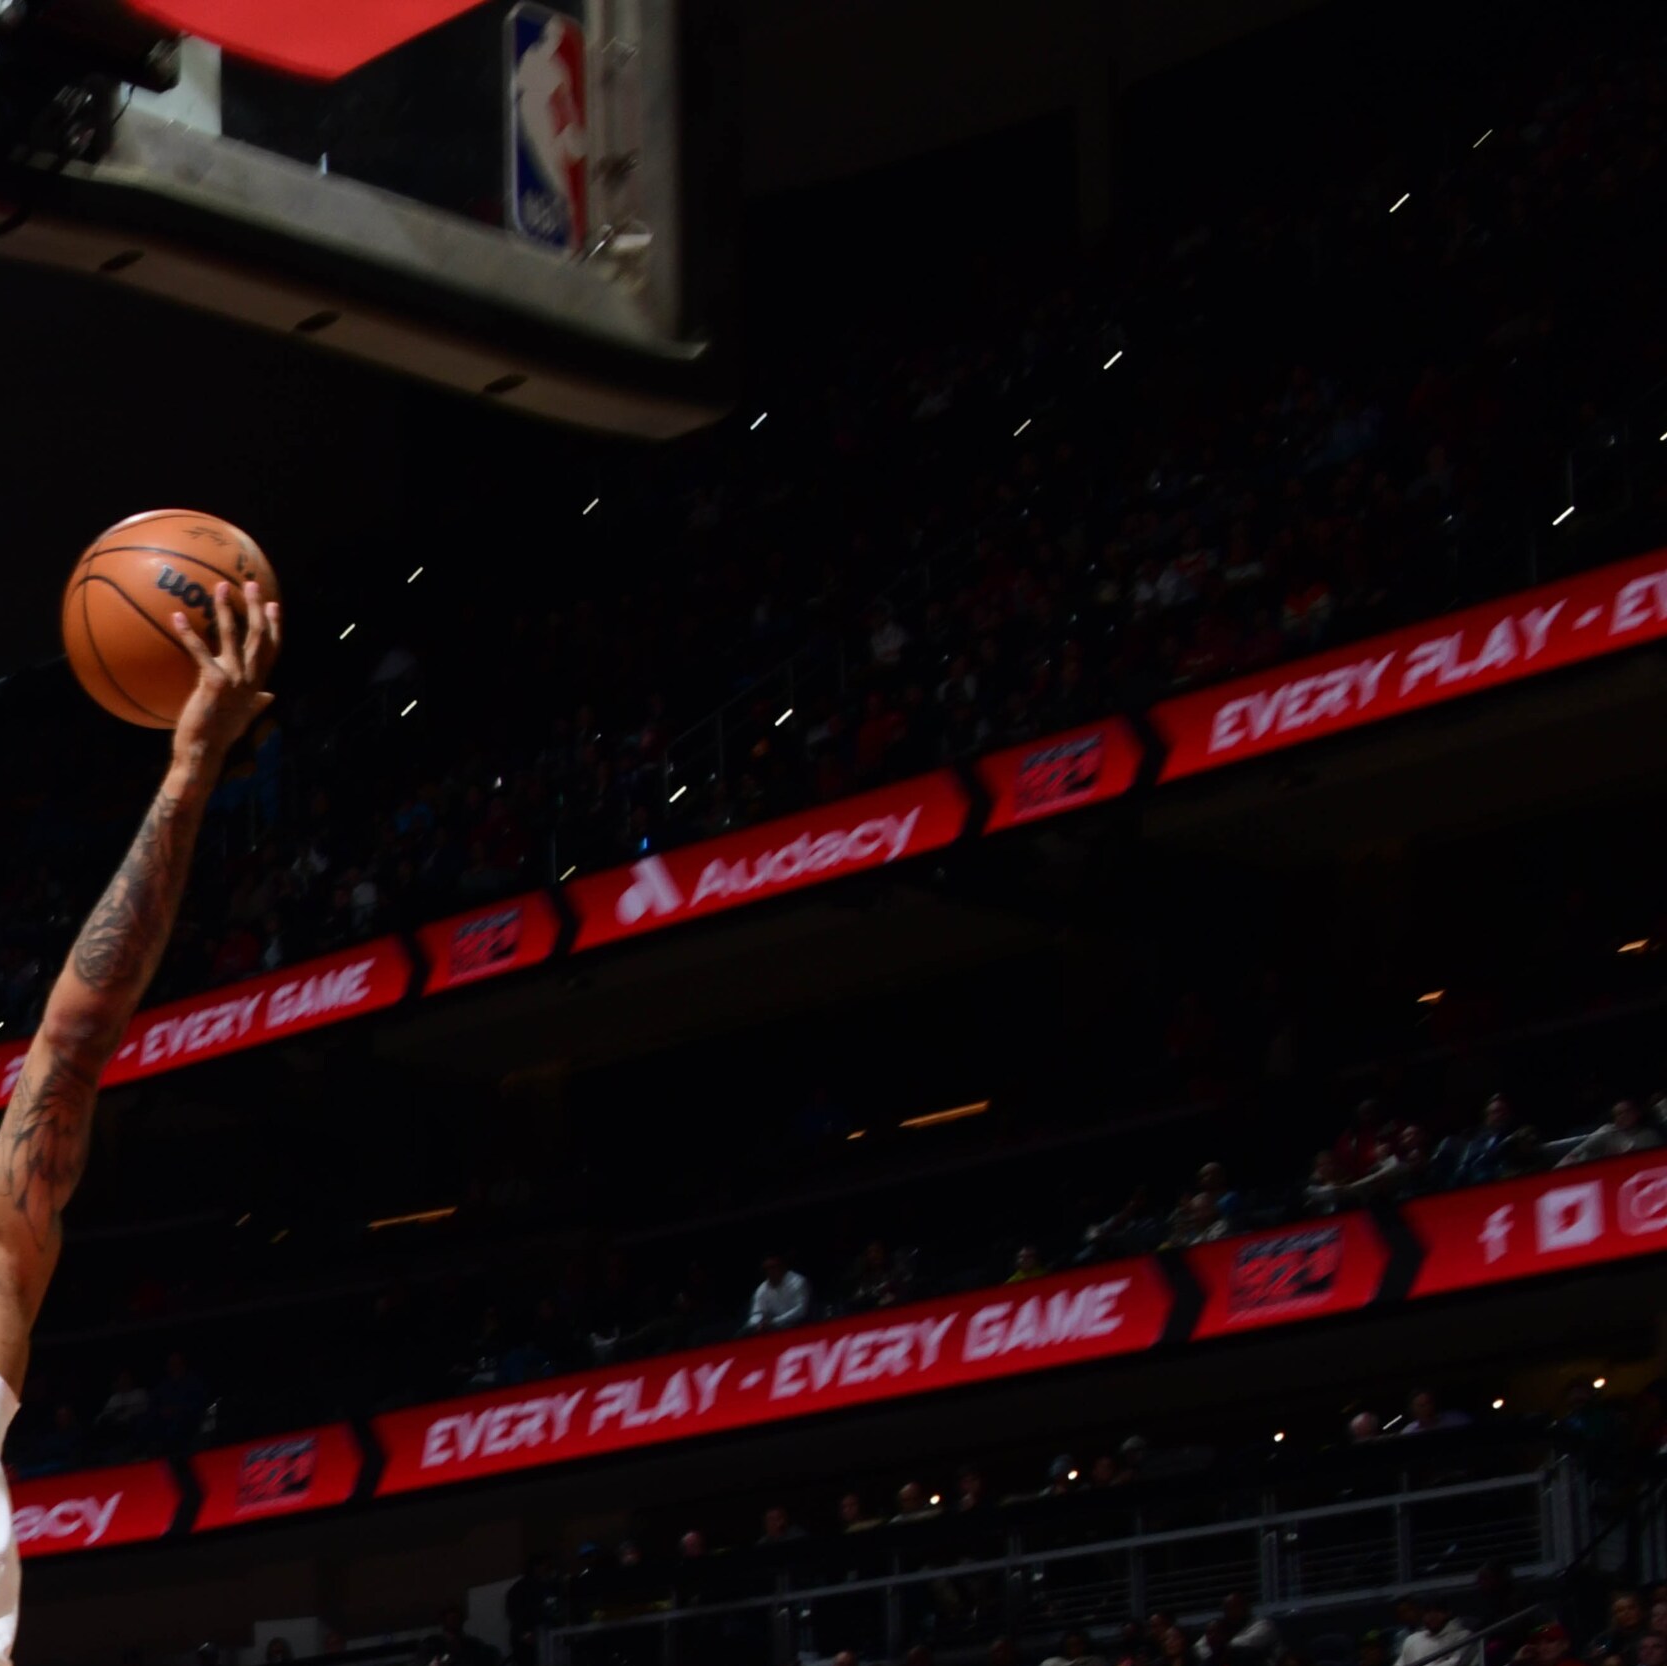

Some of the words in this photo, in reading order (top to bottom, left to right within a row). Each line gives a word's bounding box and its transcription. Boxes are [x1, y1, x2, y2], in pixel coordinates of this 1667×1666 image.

[1208, 650, 1396, 754] EVERY
[1398, 597, 1568, 698] PLAY
[688, 804, 924, 908] Audacy
[139, 997, 256, 1067] EVERY
[255, 956, 378, 1030] GAME
[420, 1386, 587, 1471] EVERY
[588, 1356, 735, 1438] PLAY
[768, 1310, 961, 1402] EVERY
[960, 1276, 1132, 1363] GAME
